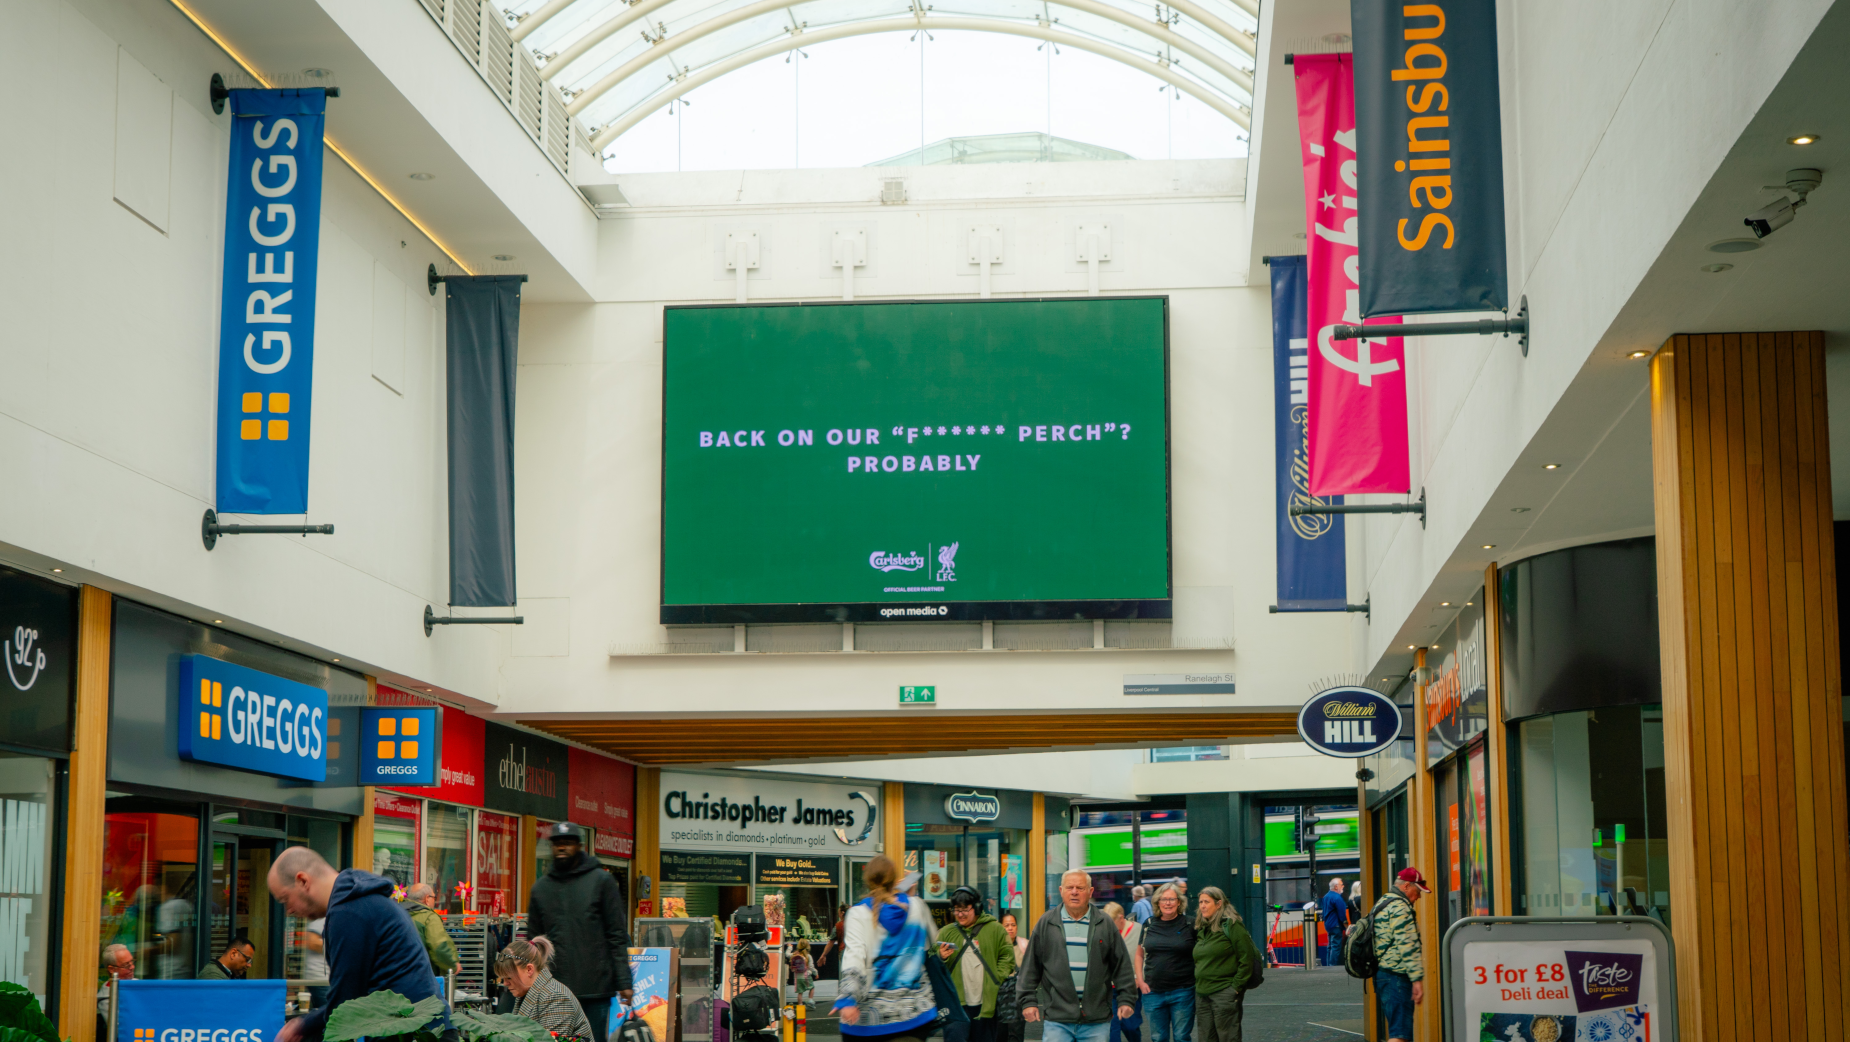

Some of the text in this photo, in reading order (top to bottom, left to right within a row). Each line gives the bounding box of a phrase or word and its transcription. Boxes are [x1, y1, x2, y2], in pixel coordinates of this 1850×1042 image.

[1391, 4, 1454, 251] Sainsbu
[243, 117, 298, 374] GREGGS
[699, 430, 766, 448] BACK
[777, 429, 814, 446] ON
[826, 428, 880, 446] OUR
[847, 454, 981, 473] PROBABLY
[869, 551, 924, 572] Carlsberg
[880, 606, 937, 618] open media
[1460, 619, 1480, 703] Local
[1185, 674, 1222, 683] Ranelagh
[1323, 701, 1376, 718] William
[227, 686, 323, 760] GREGGS
[1324, 720, 1376, 743] HILL
[376, 765, 418, 775] GREGGS
[452, 768, 463, 786] great
[464, 772, 475, 786] value
[664, 790, 855, 829] Christopher James
[953, 799, 996, 813] CINNABON
[671, 829, 825, 848] specialists in diamonds platinum gold
[478, 831, 511, 875] SALE
[662, 855, 672, 864] We
[673, 856, 686, 866] Buy
[687, 856, 712, 864] Certified
[776, 859, 785, 867] We
[786, 859, 797, 869] Buy
[1474, 963, 1565, 985] 3 for £8
[1578, 960, 1633, 995] taste
[1501, 986, 1569, 1001] Deli deal
[160, 1028, 262, 1042] GREGGS
